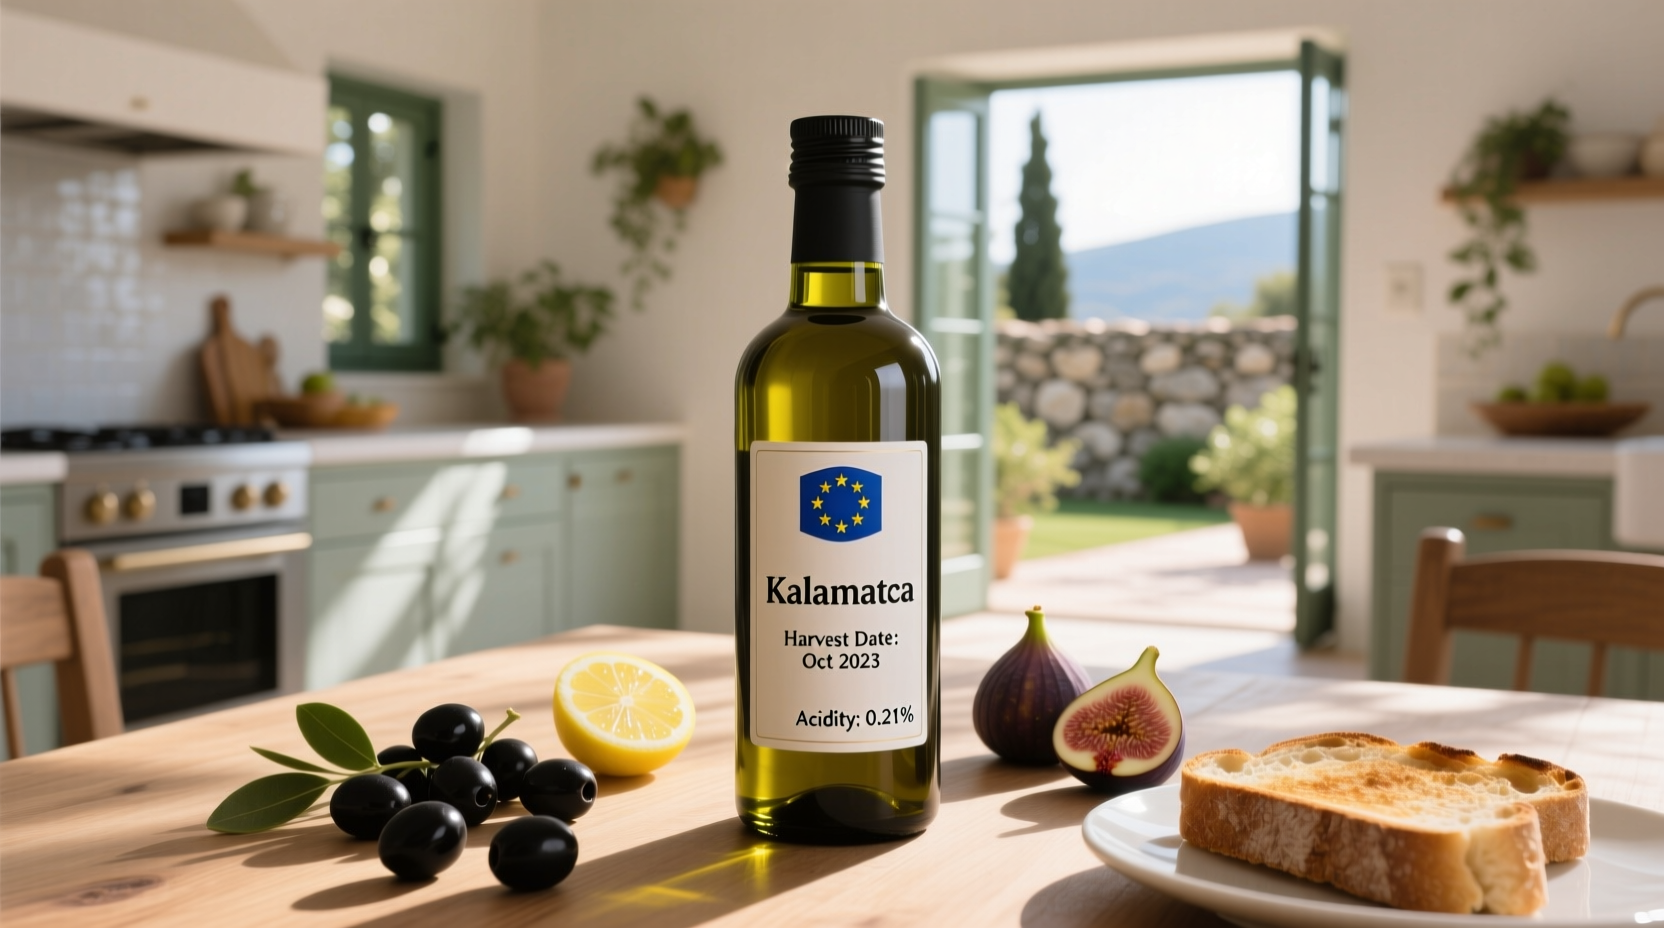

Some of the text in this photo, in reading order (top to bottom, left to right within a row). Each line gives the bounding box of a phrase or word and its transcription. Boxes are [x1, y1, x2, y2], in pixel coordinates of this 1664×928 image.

[766, 576, 914, 605] Kalamatca
[784, 630, 899, 647] Harvest Date:
[802, 653, 880, 669] Oct 2023
[796, 705, 914, 732] Acidity: 0.21%
